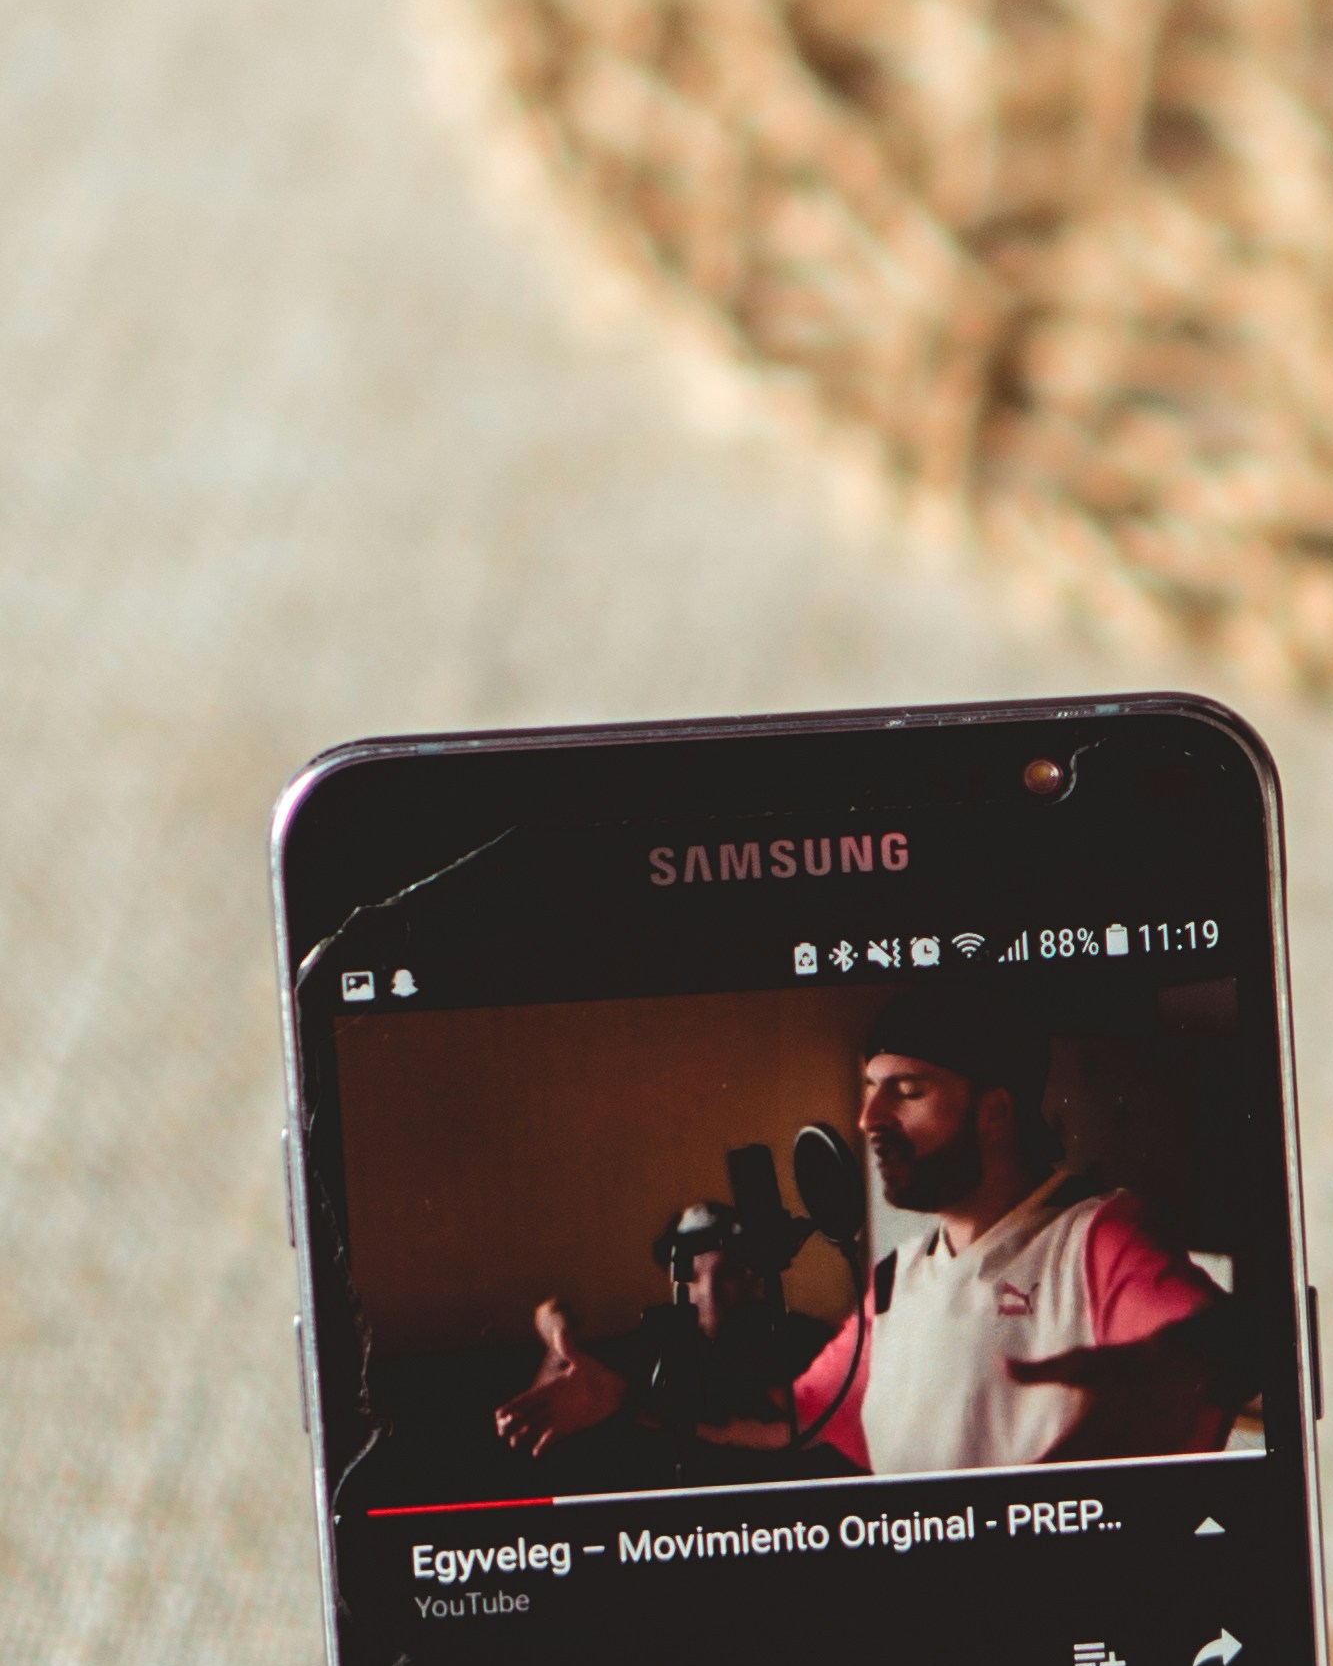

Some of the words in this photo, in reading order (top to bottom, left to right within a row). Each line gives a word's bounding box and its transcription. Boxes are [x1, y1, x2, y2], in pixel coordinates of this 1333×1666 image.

[650, 831, 909, 885] SAMSUNG
[1039, 927, 1100, 959] 88%
[1138, 919, 1219, 953] 11:19
[412, 1536, 572, 1584] Egyveleg
[618, 1521, 830, 1564] Movimiento
[839, 1506, 975, 1552] Original
[414, 1590, 530, 1619] YouTube
